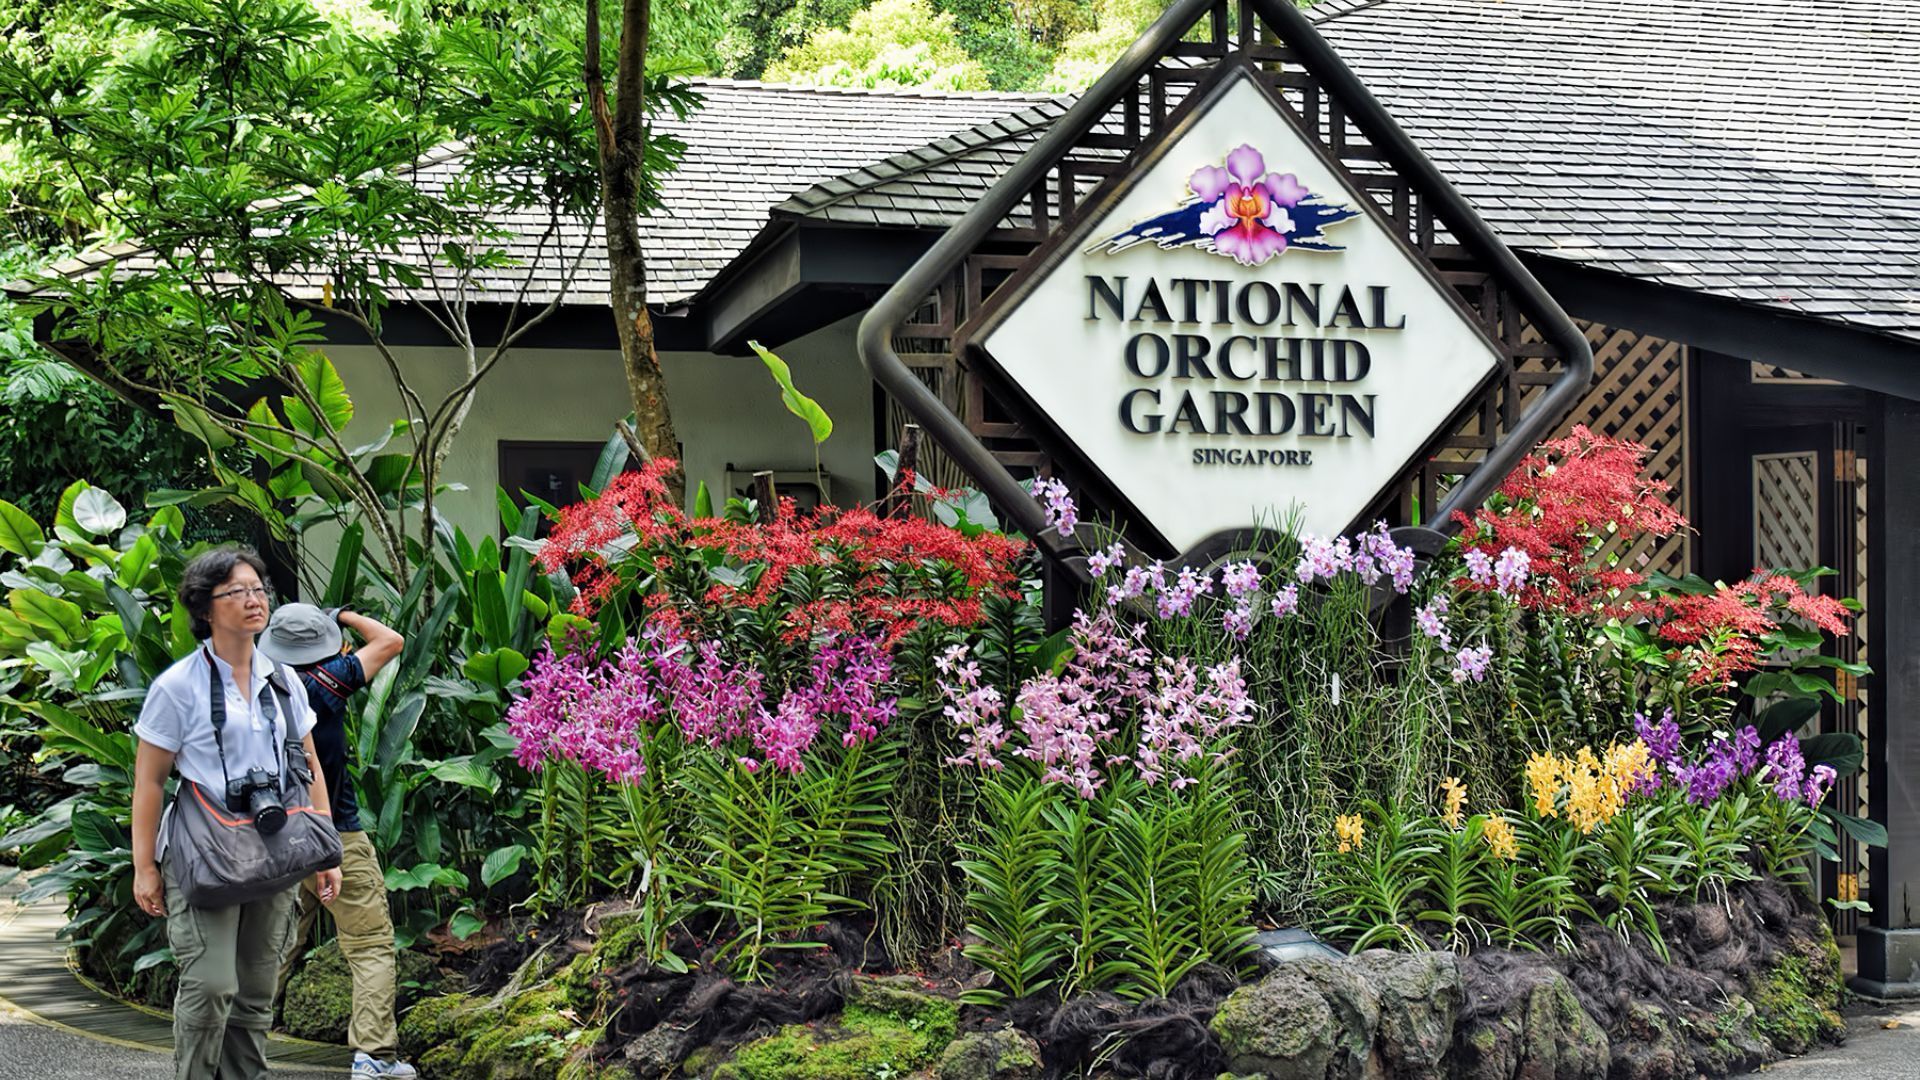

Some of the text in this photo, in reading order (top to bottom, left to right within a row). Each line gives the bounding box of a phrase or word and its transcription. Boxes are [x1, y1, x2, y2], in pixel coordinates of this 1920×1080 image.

[1084, 275, 1406, 329] NATIONAL
[1124, 333, 1371, 382] ORCHID
[1118, 388, 1379, 438] GARDEN
[1192, 448, 1313, 466] SINGAPORE
